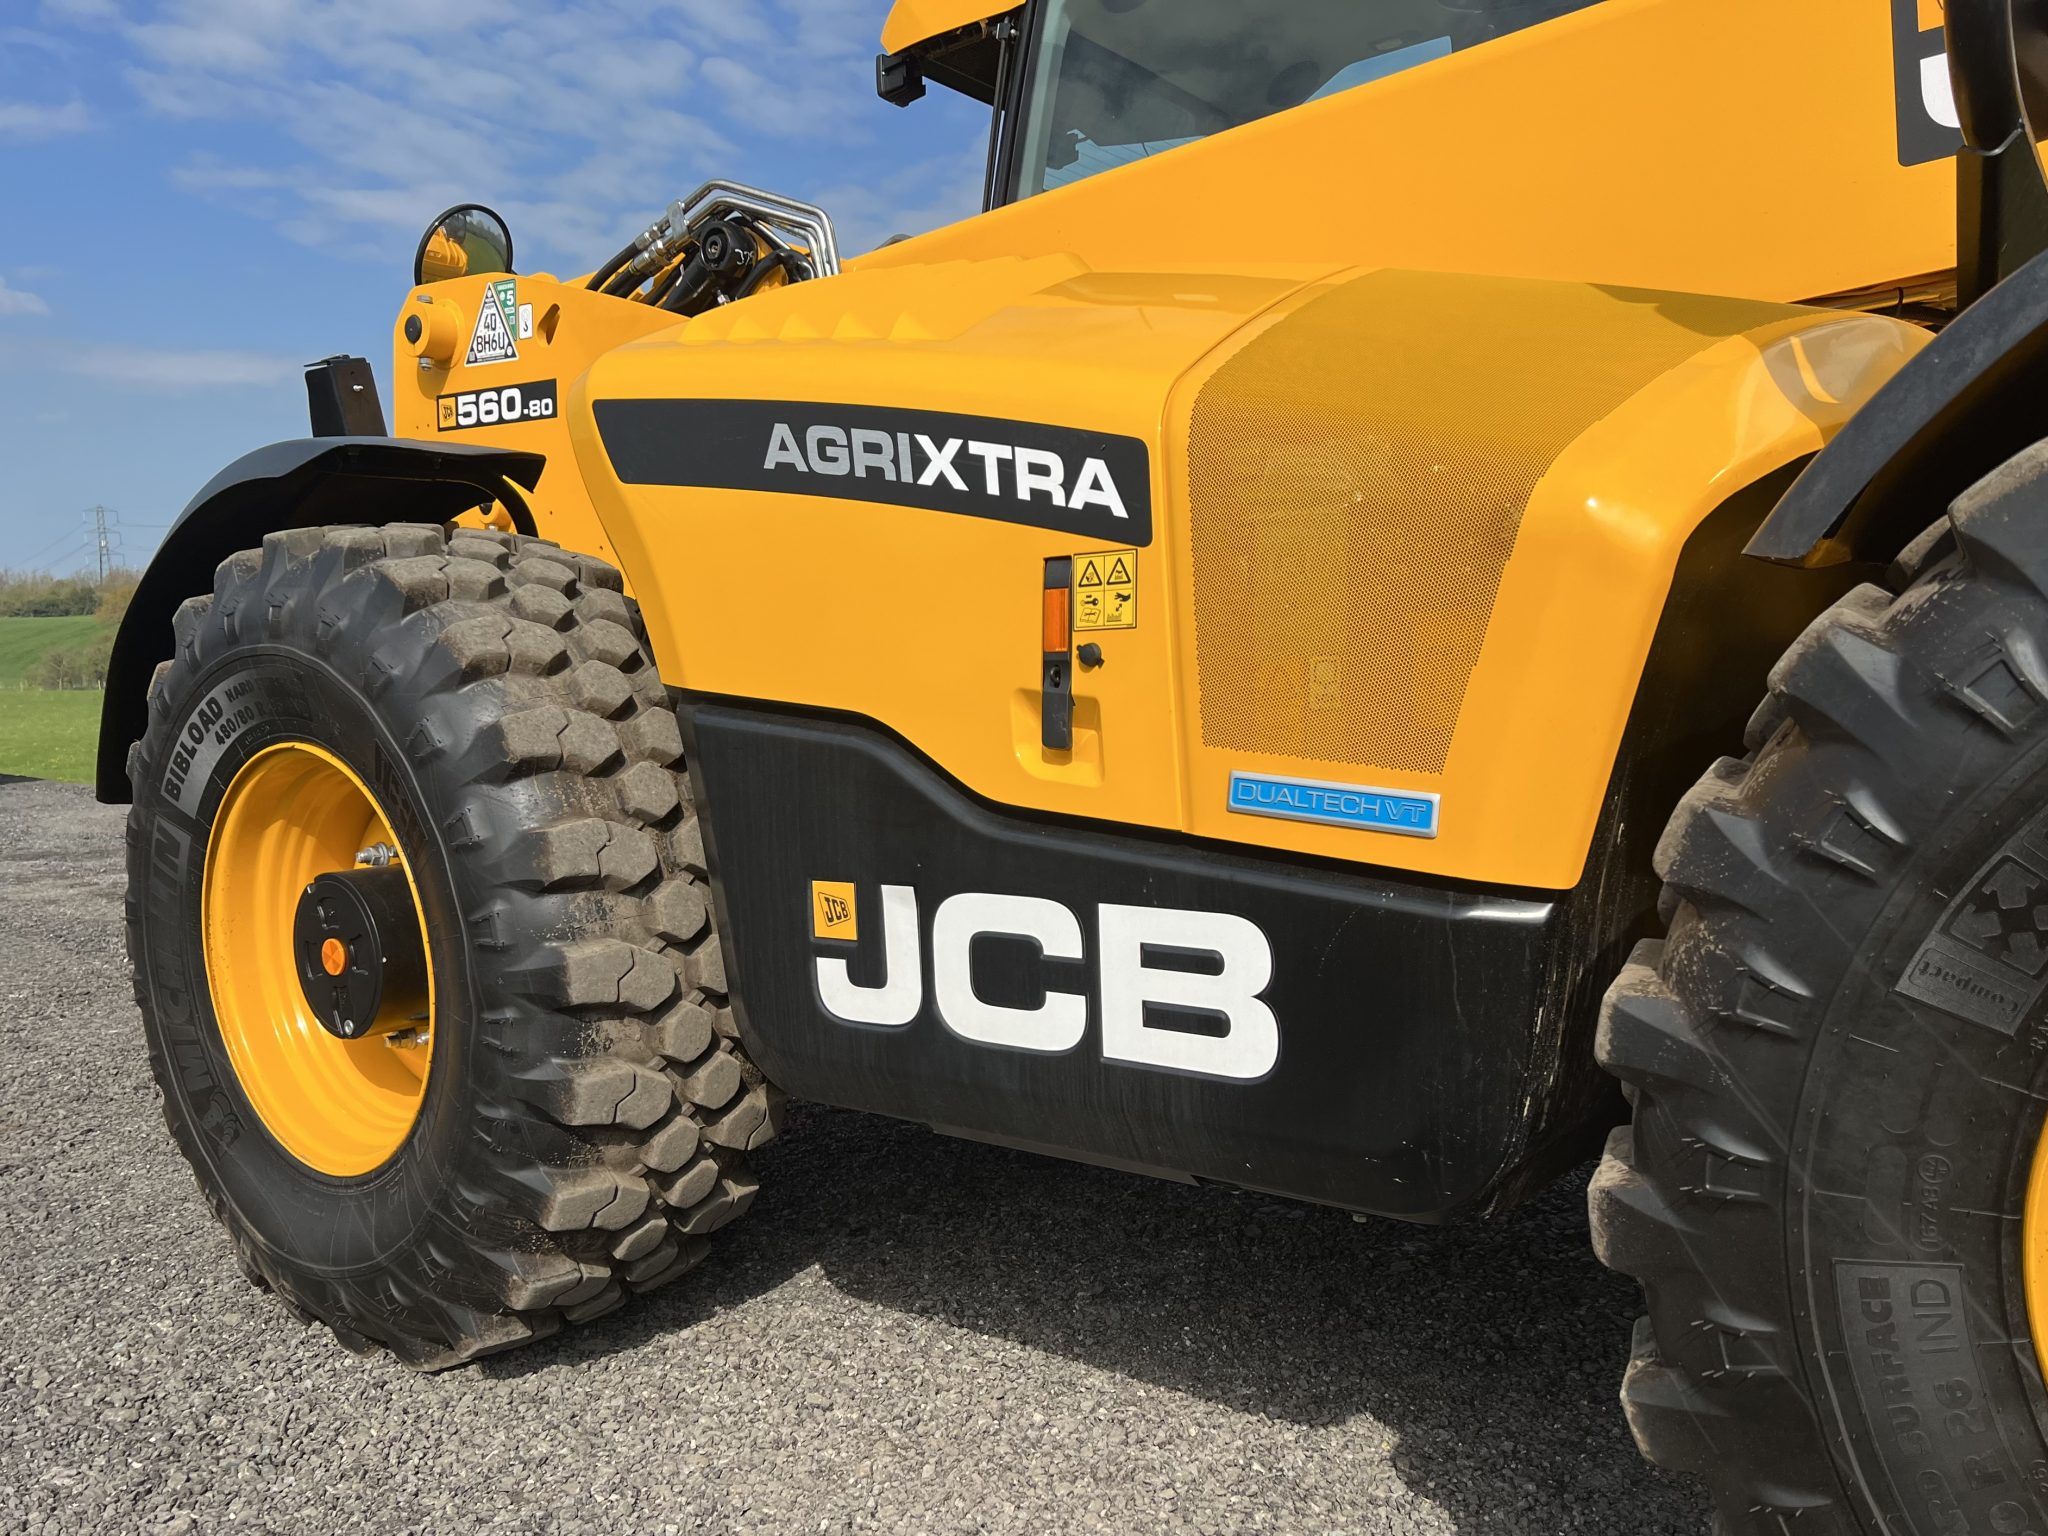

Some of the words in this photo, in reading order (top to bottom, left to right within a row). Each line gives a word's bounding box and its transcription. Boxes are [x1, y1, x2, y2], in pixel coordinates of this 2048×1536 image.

[763, 422, 1129, 519] AGRIXTRA
[164, 696, 223, 802] BIBLOAD
[214, 705, 255, 746] 480/80
[825, 893, 850, 924] JCB
[816, 884, 1279, 1079] JCB
[1910, 1278, 1961, 1355] IND
[1858, 1276, 1931, 1456] SURFACE
